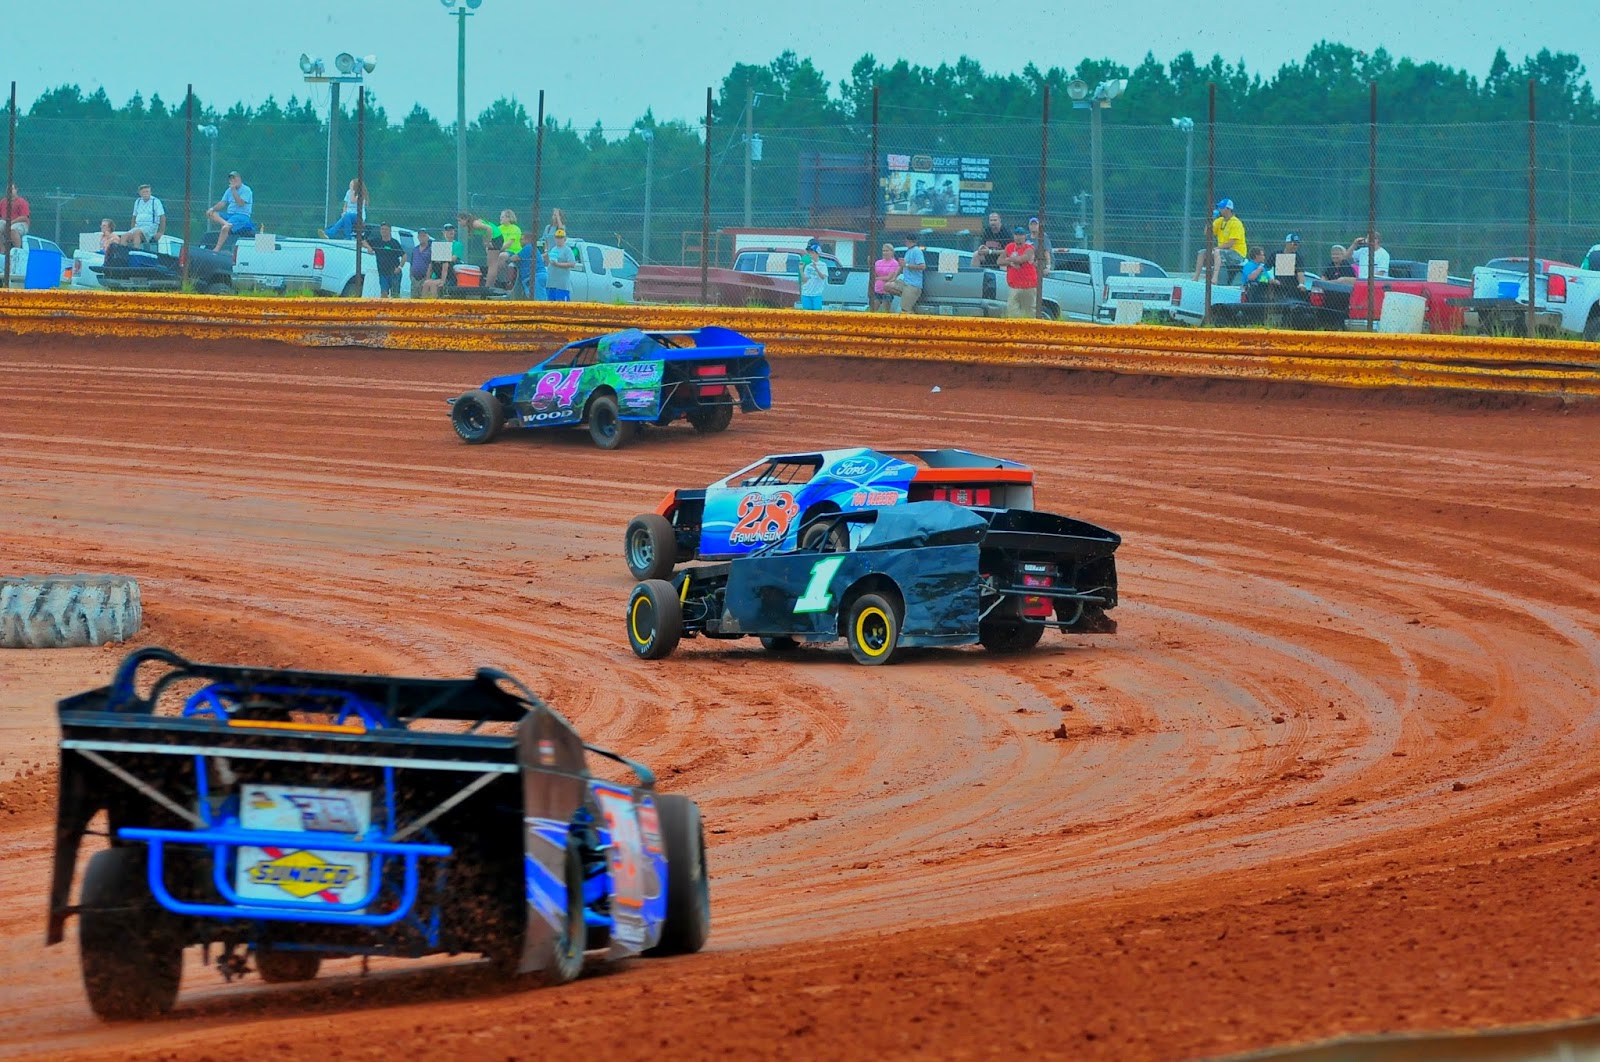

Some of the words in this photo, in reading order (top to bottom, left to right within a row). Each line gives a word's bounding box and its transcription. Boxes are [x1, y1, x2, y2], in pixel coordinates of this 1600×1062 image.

[523, 410, 573, 421] WOOD
[836, 459, 869, 475] Ford
[733, 531, 783, 543] TOMLINSON
[793, 556, 845, 613] 1
